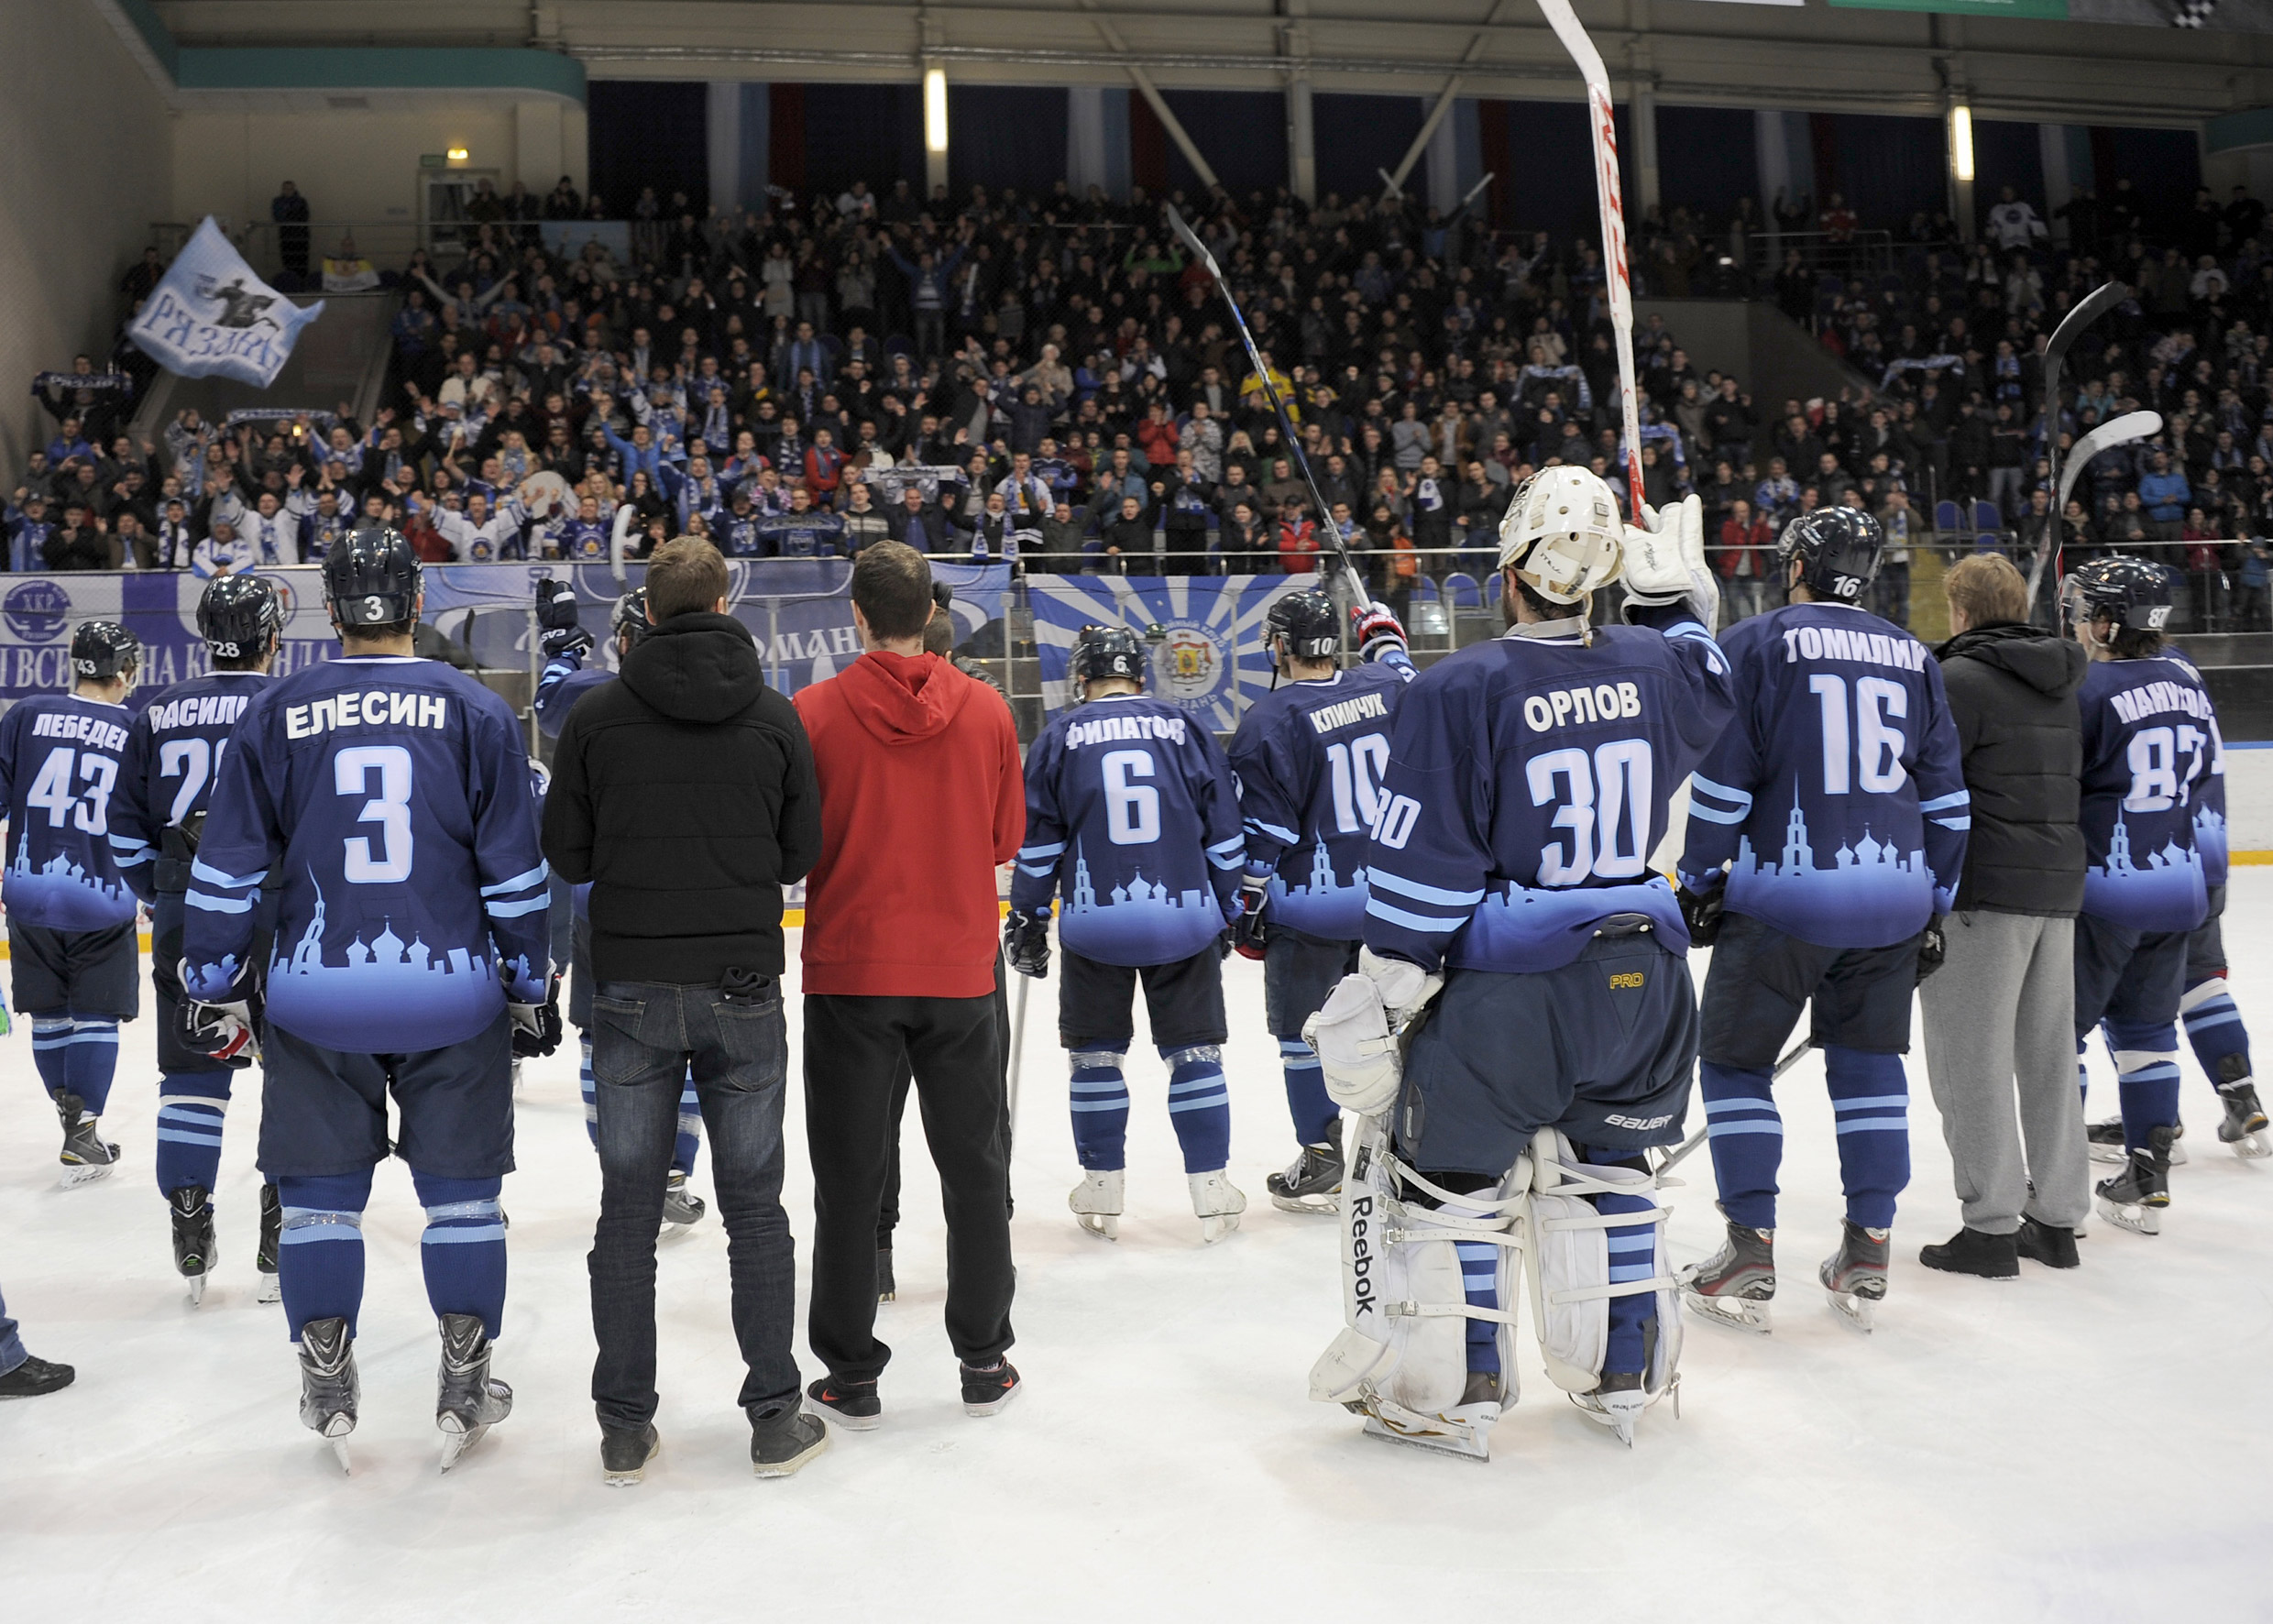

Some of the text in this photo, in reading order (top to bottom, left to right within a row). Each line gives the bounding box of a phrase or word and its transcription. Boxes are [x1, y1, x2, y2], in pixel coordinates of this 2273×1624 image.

[1833, 575, 1861, 597] 16
[364, 596, 385, 620] 3
[2147, 607, 2172, 628] 87
[215, 640, 240, 658] 28
[1113, 654, 1128, 675] 6
[1310, 637, 1334, 655] 10
[15, 647, 71, 687] ВСЕ
[77, 660, 96, 675] 43
[286, 690, 446, 740] ЕЛЕСИН
[1310, 693, 1388, 734] КЛИМЧУК
[1523, 681, 1642, 732] ОРЛОВ
[1065, 715, 1186, 751] ФИЛАТОВ
[1809, 674, 1907, 796] 16
[1326, 732, 1391, 833] 10
[2123, 725, 2207, 813] 87
[27, 746, 119, 837] 43
[1102, 749, 1161, 845] 6
[335, 745, 413, 883] 3
[1525, 738, 1653, 887] 30
[1609, 972, 1644, 990] PRO
[1351, 1195, 1377, 1319] Reebok
